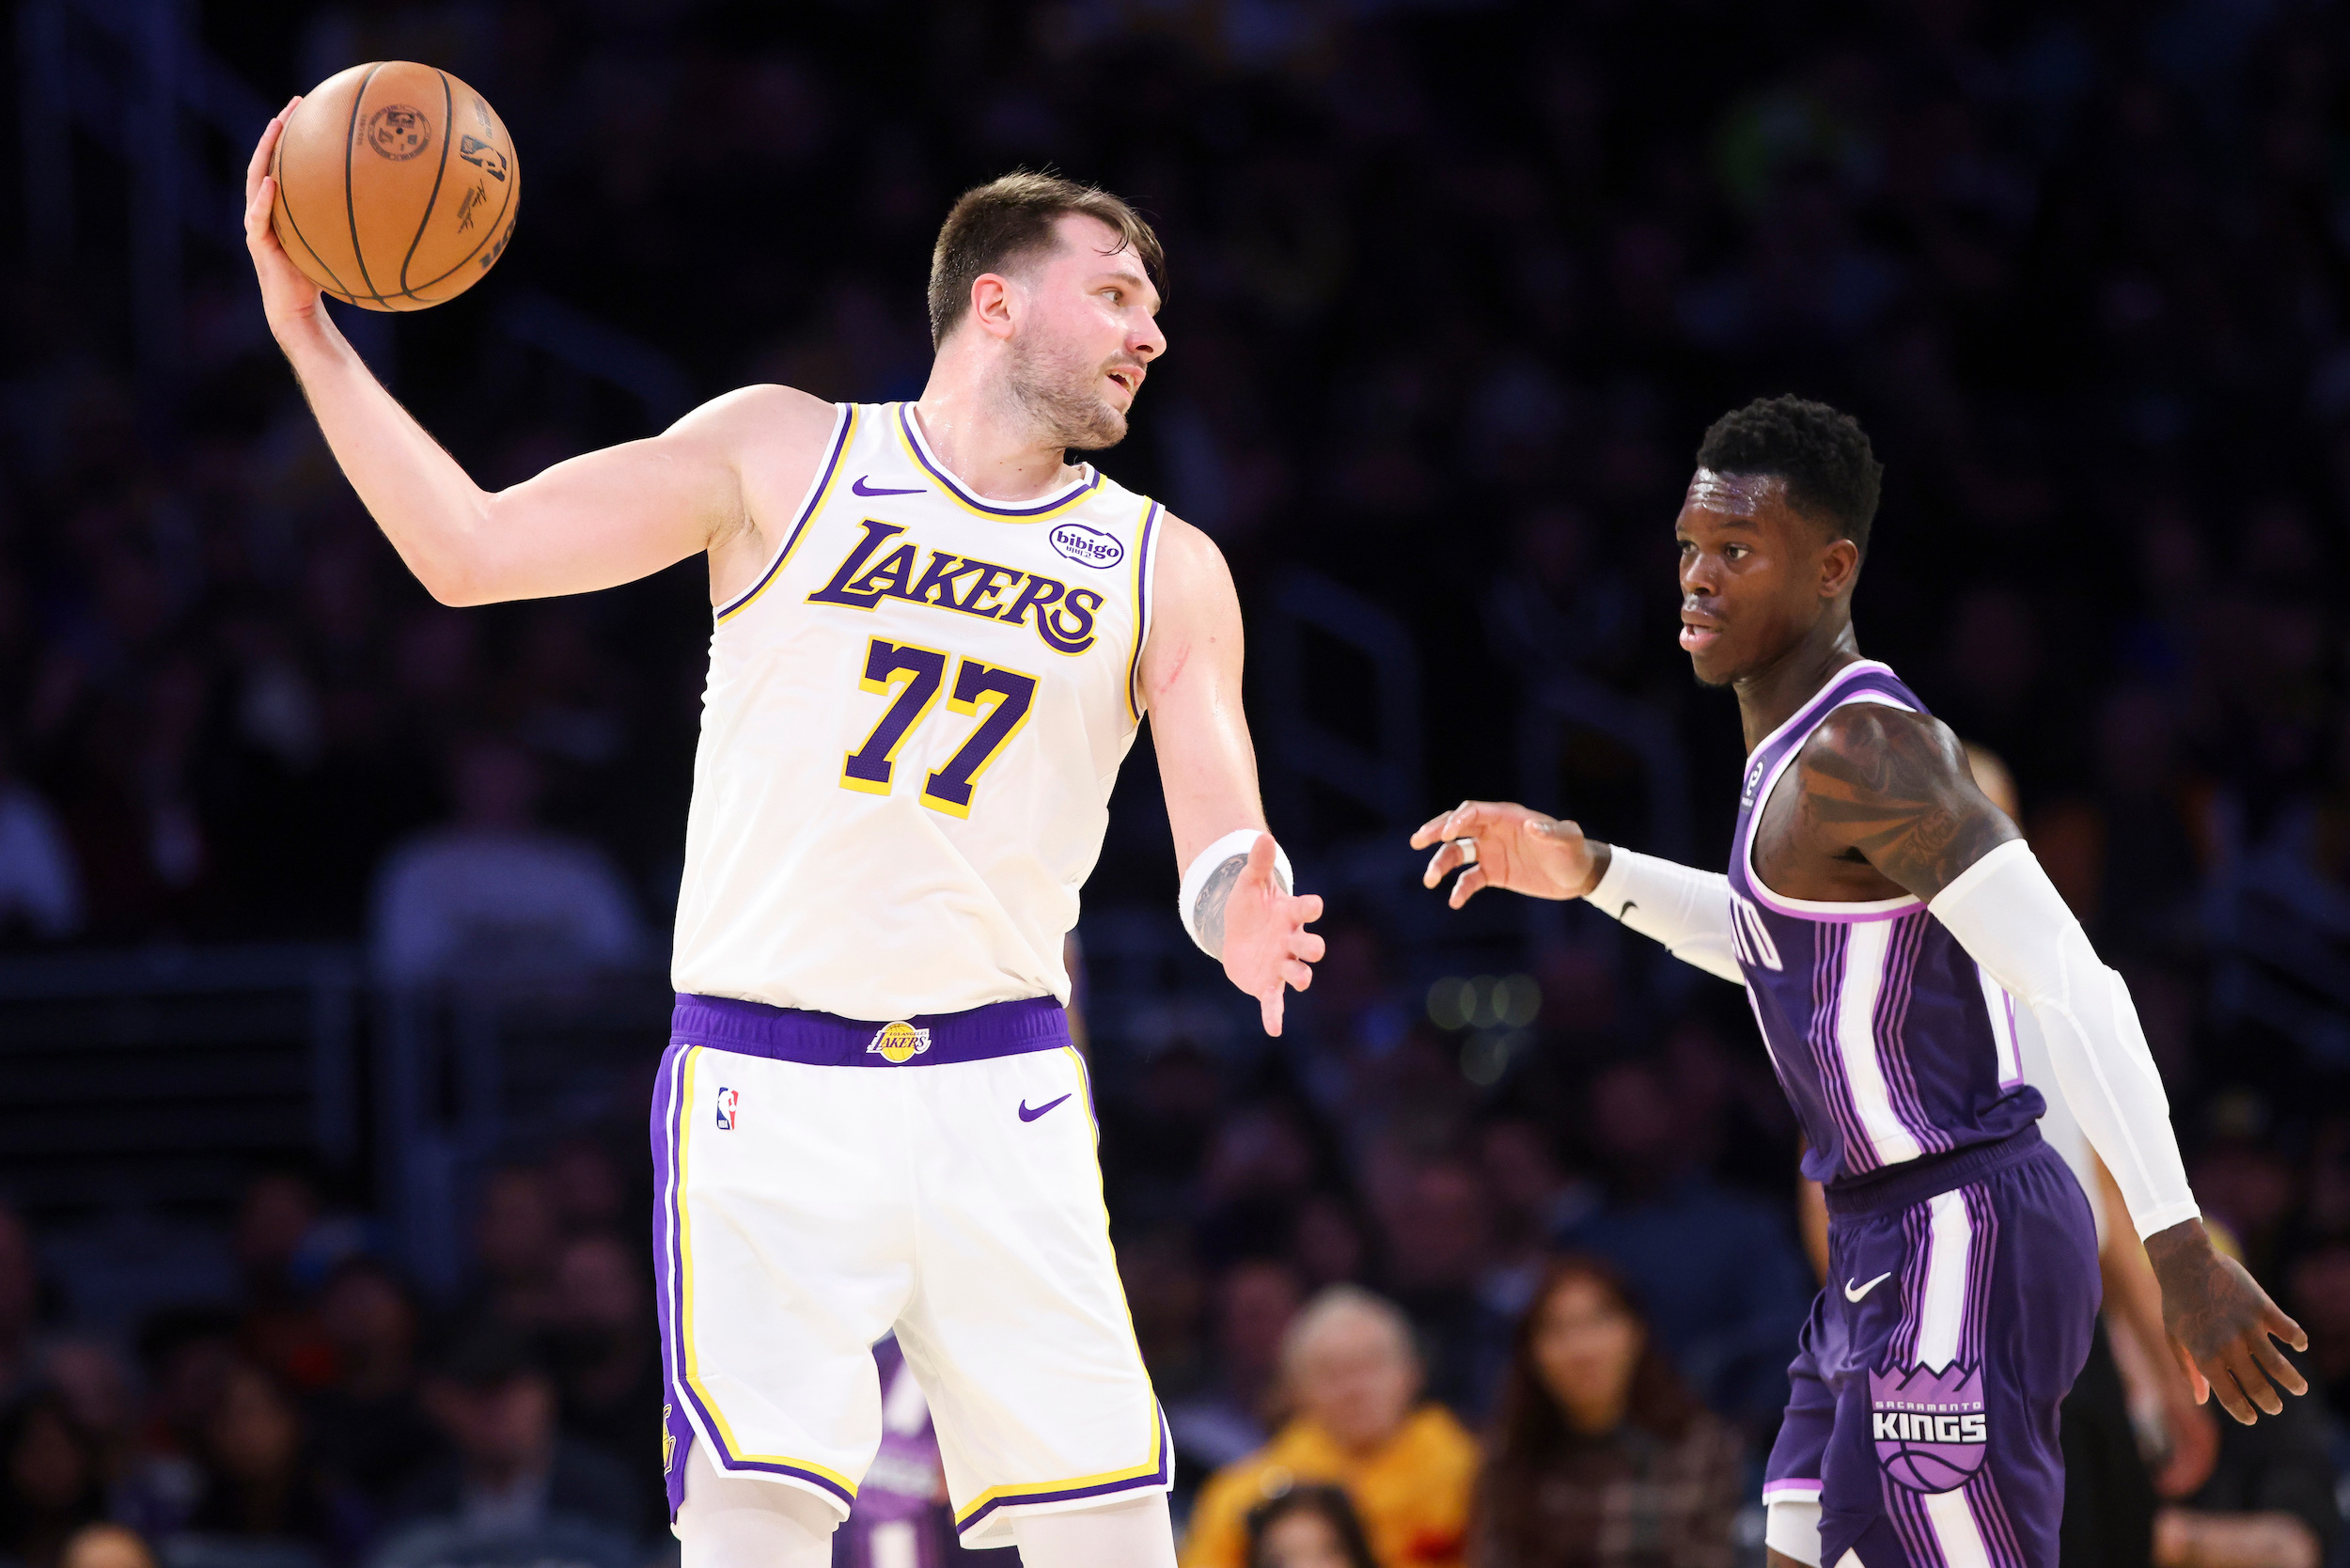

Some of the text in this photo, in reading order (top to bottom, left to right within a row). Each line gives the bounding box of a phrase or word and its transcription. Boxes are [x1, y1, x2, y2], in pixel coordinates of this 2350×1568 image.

[1057, 531, 1120, 559] bibigo
[804, 517, 1107, 656] LAKERS
[839, 635, 1041, 820] 77
[870, 1032, 929, 1052] LAKERS
[1875, 1401, 1982, 1412] SACRAMENTO
[1872, 1413, 1987, 1442] KINGS
